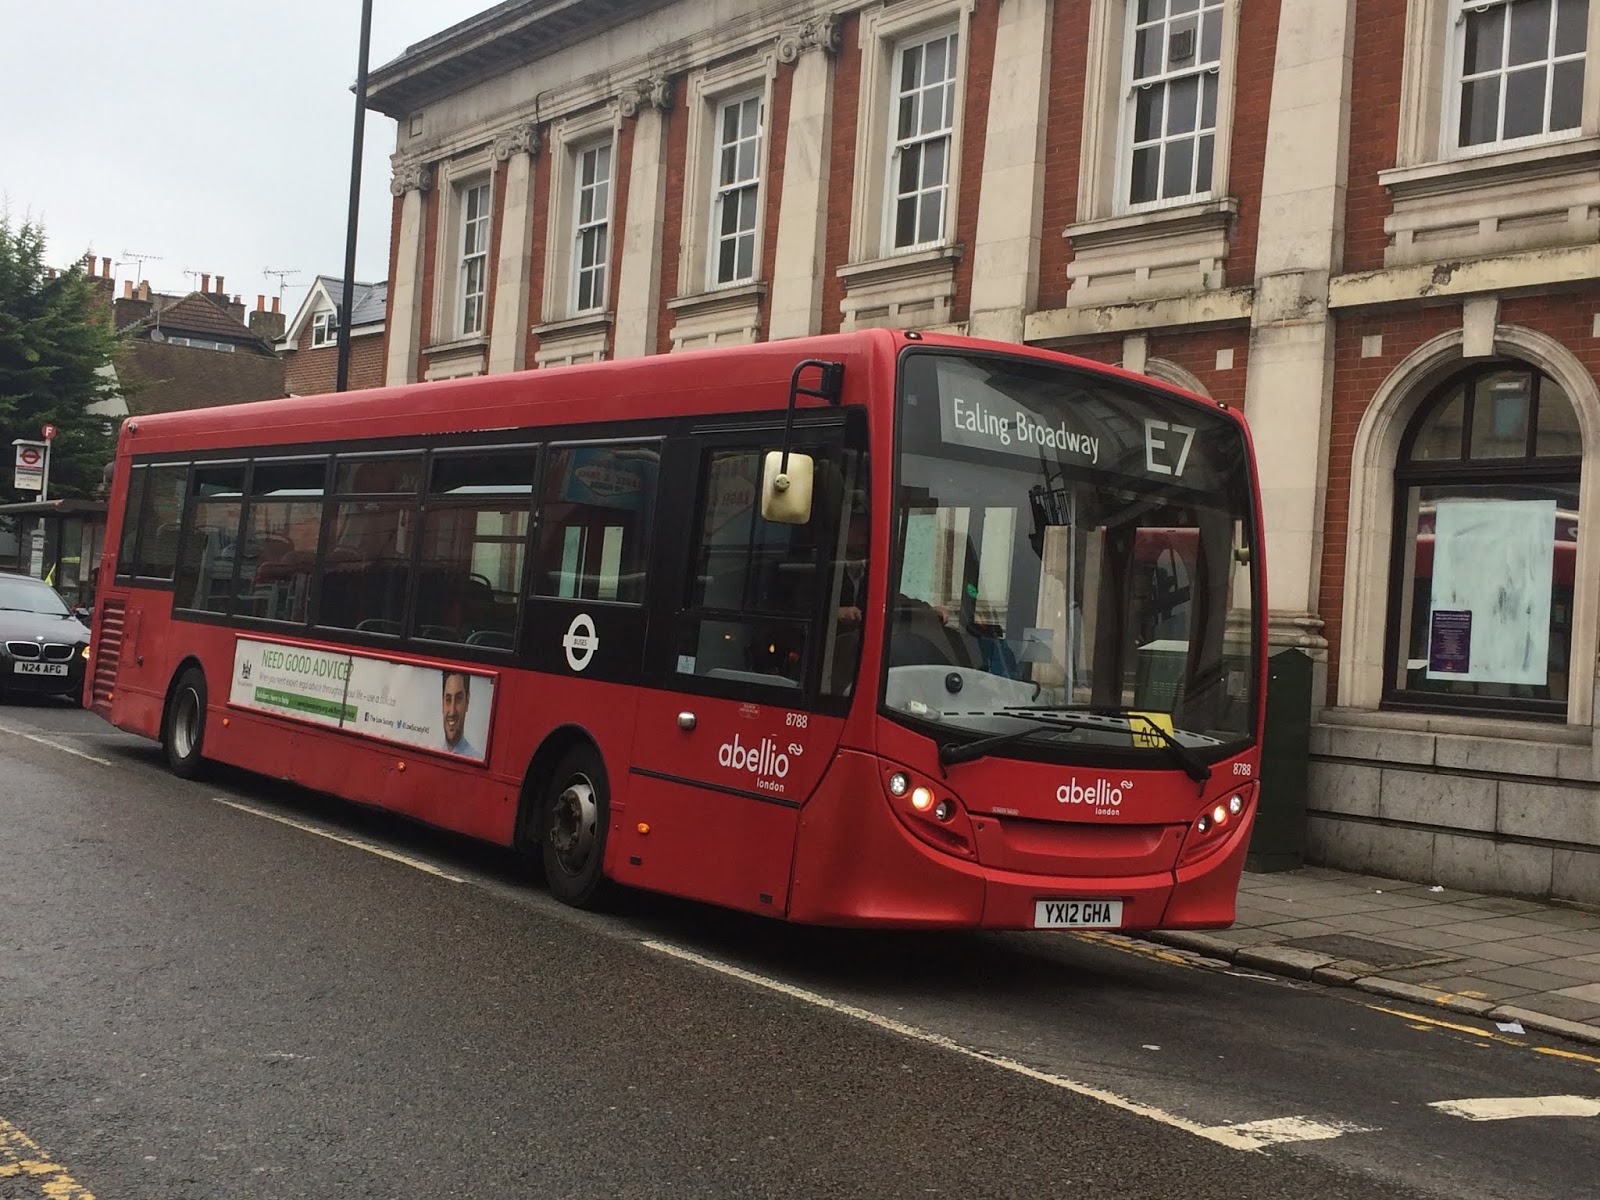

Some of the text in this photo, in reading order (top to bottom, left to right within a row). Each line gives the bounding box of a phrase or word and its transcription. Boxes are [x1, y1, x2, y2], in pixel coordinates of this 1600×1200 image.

[45, 426, 53, 437] F
[953, 397, 1099, 464] Ealing Broadway
[1144, 418, 1197, 477] E7
[21, 663, 61, 674] N24 AFG
[261, 649, 284, 670] NEED
[285, 653, 312, 674] GOOD
[785, 712, 808, 729] 8788
[718, 733, 789, 778] abellio
[1232, 763, 1252, 776] 8788
[756, 777, 785, 792] london
[1056, 777, 1123, 806] abellio
[1095, 807, 1120, 816] london
[1045, 903, 1111, 923] YX12 GHA
